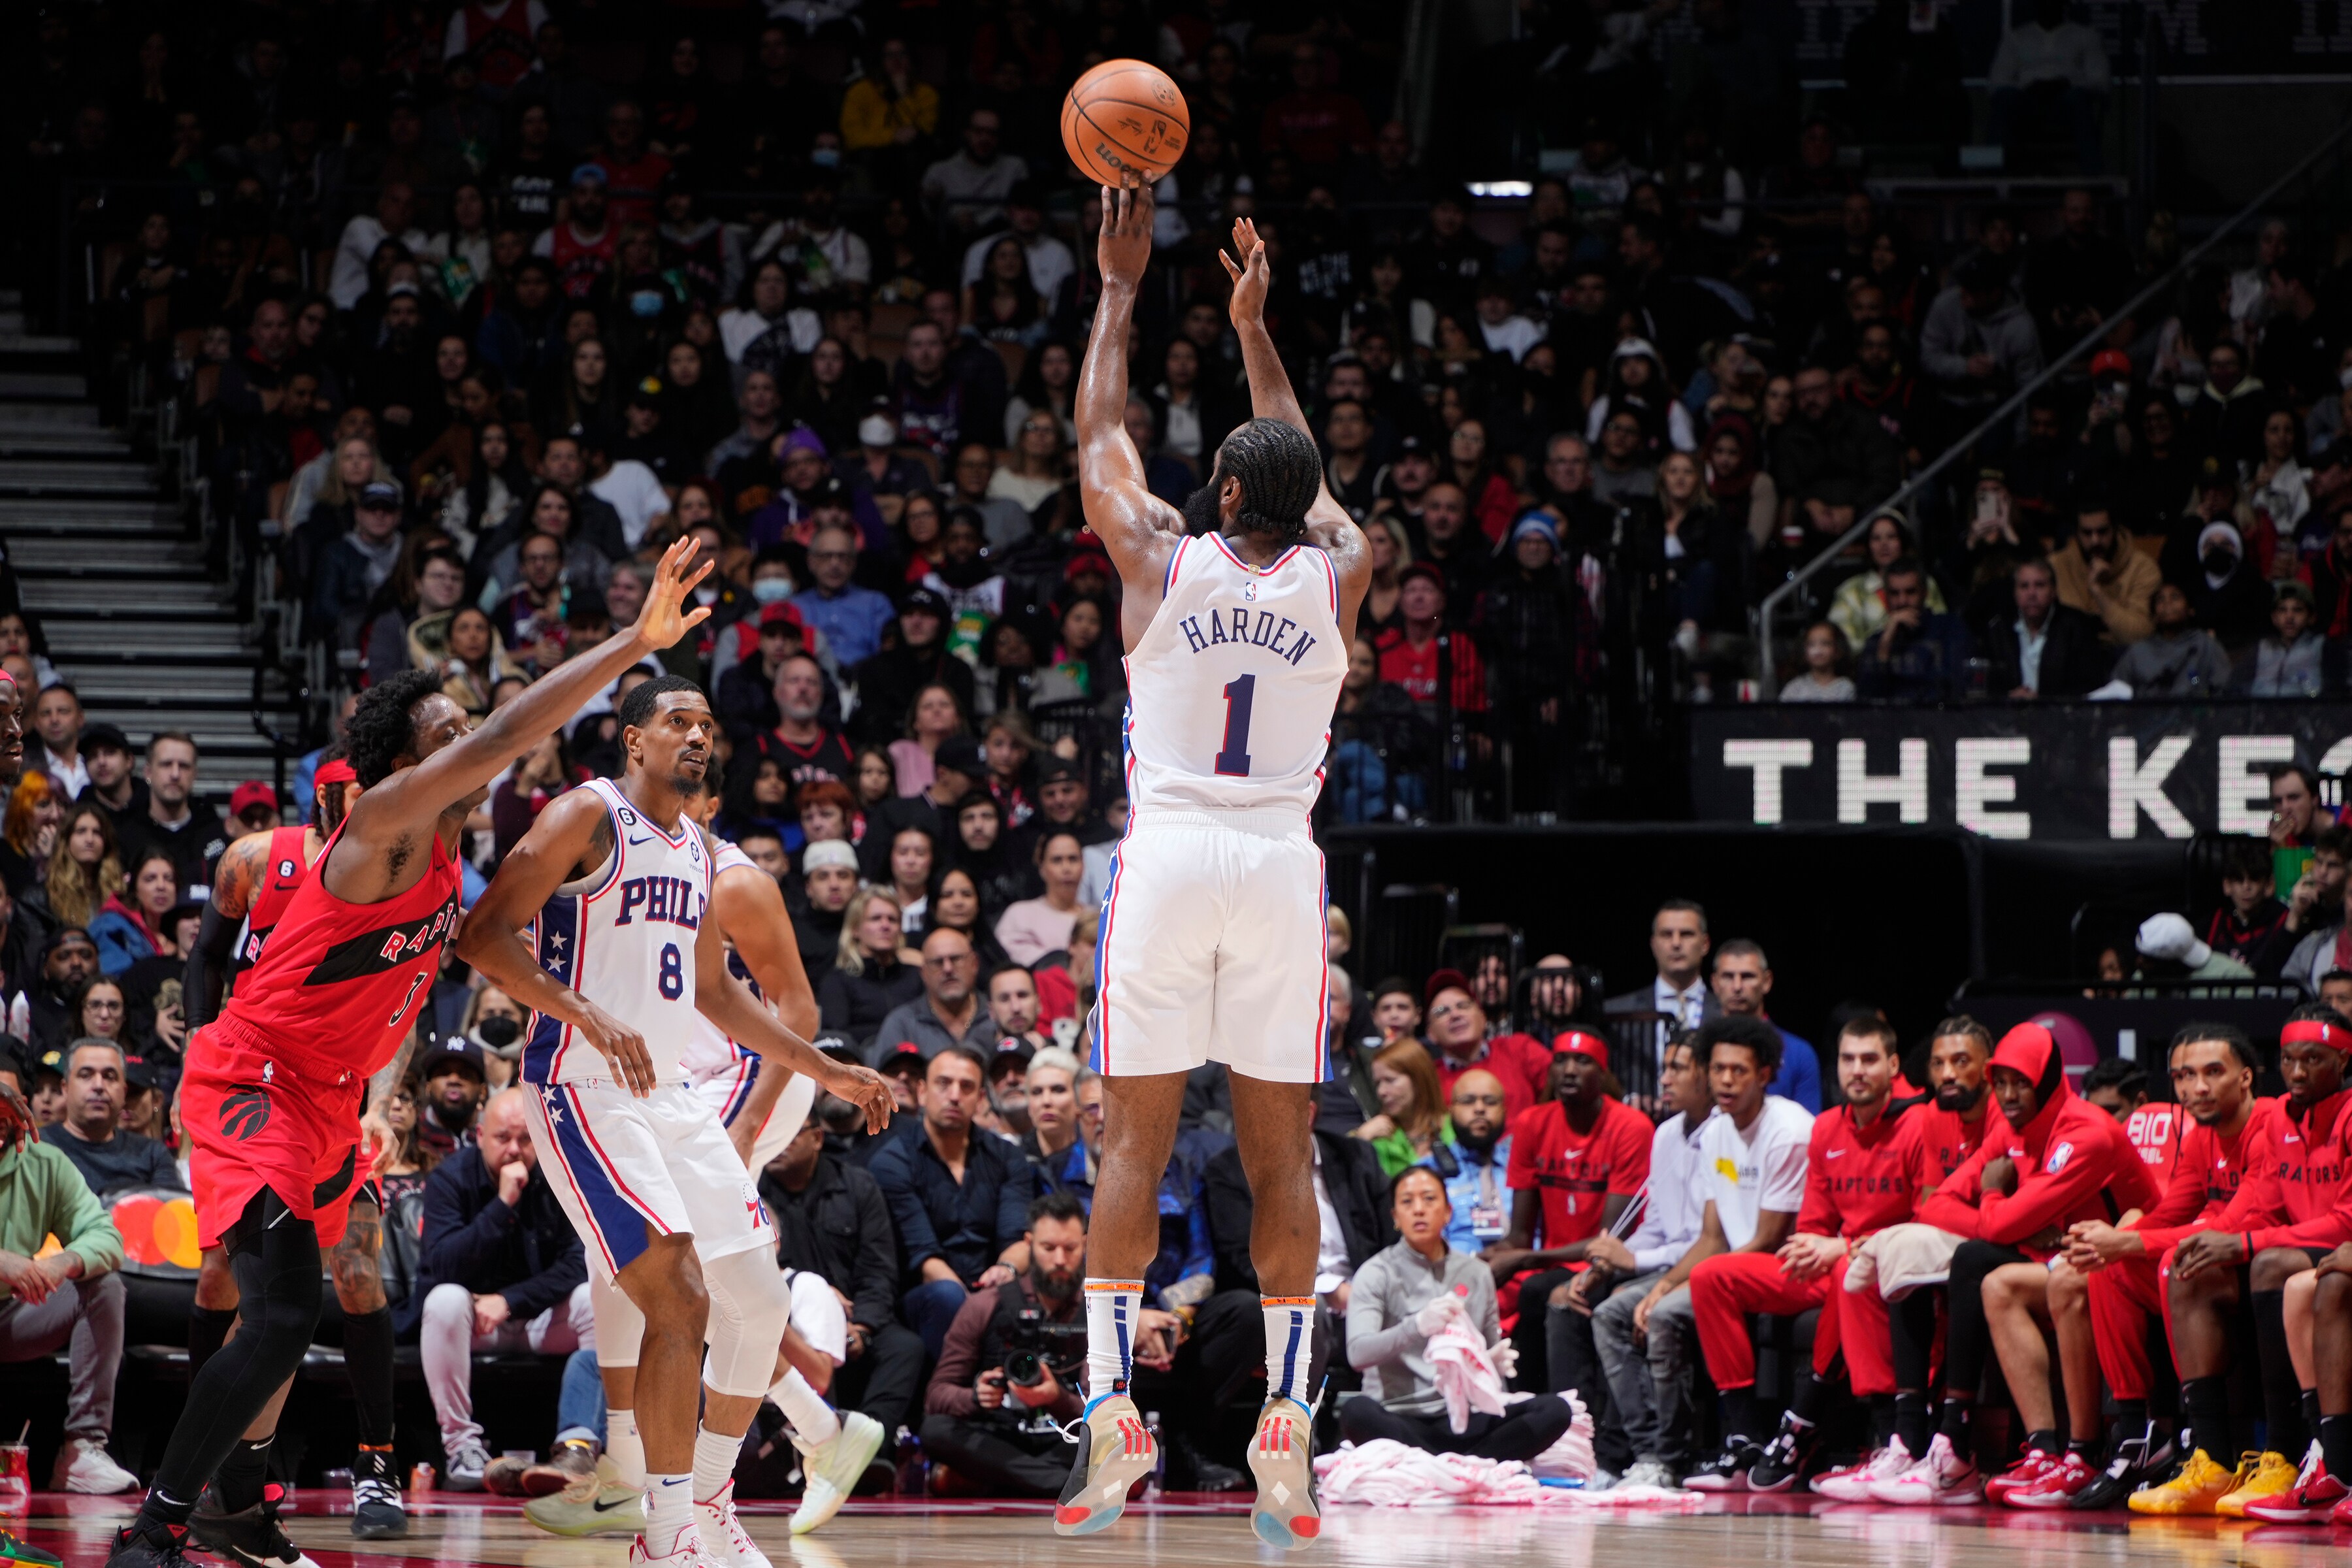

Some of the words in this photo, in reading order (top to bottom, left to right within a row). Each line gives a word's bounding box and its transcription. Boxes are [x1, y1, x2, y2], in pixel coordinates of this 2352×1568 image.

[1179, 608, 1316, 666] HARDEN
[1215, 674, 1256, 777] 1
[620, 809, 633, 825] 6
[1723, 738, 2031, 840] THE
[2108, 735, 2352, 839] KE
[280, 860, 293, 877] 6
[658, 942, 683, 1002] 8
